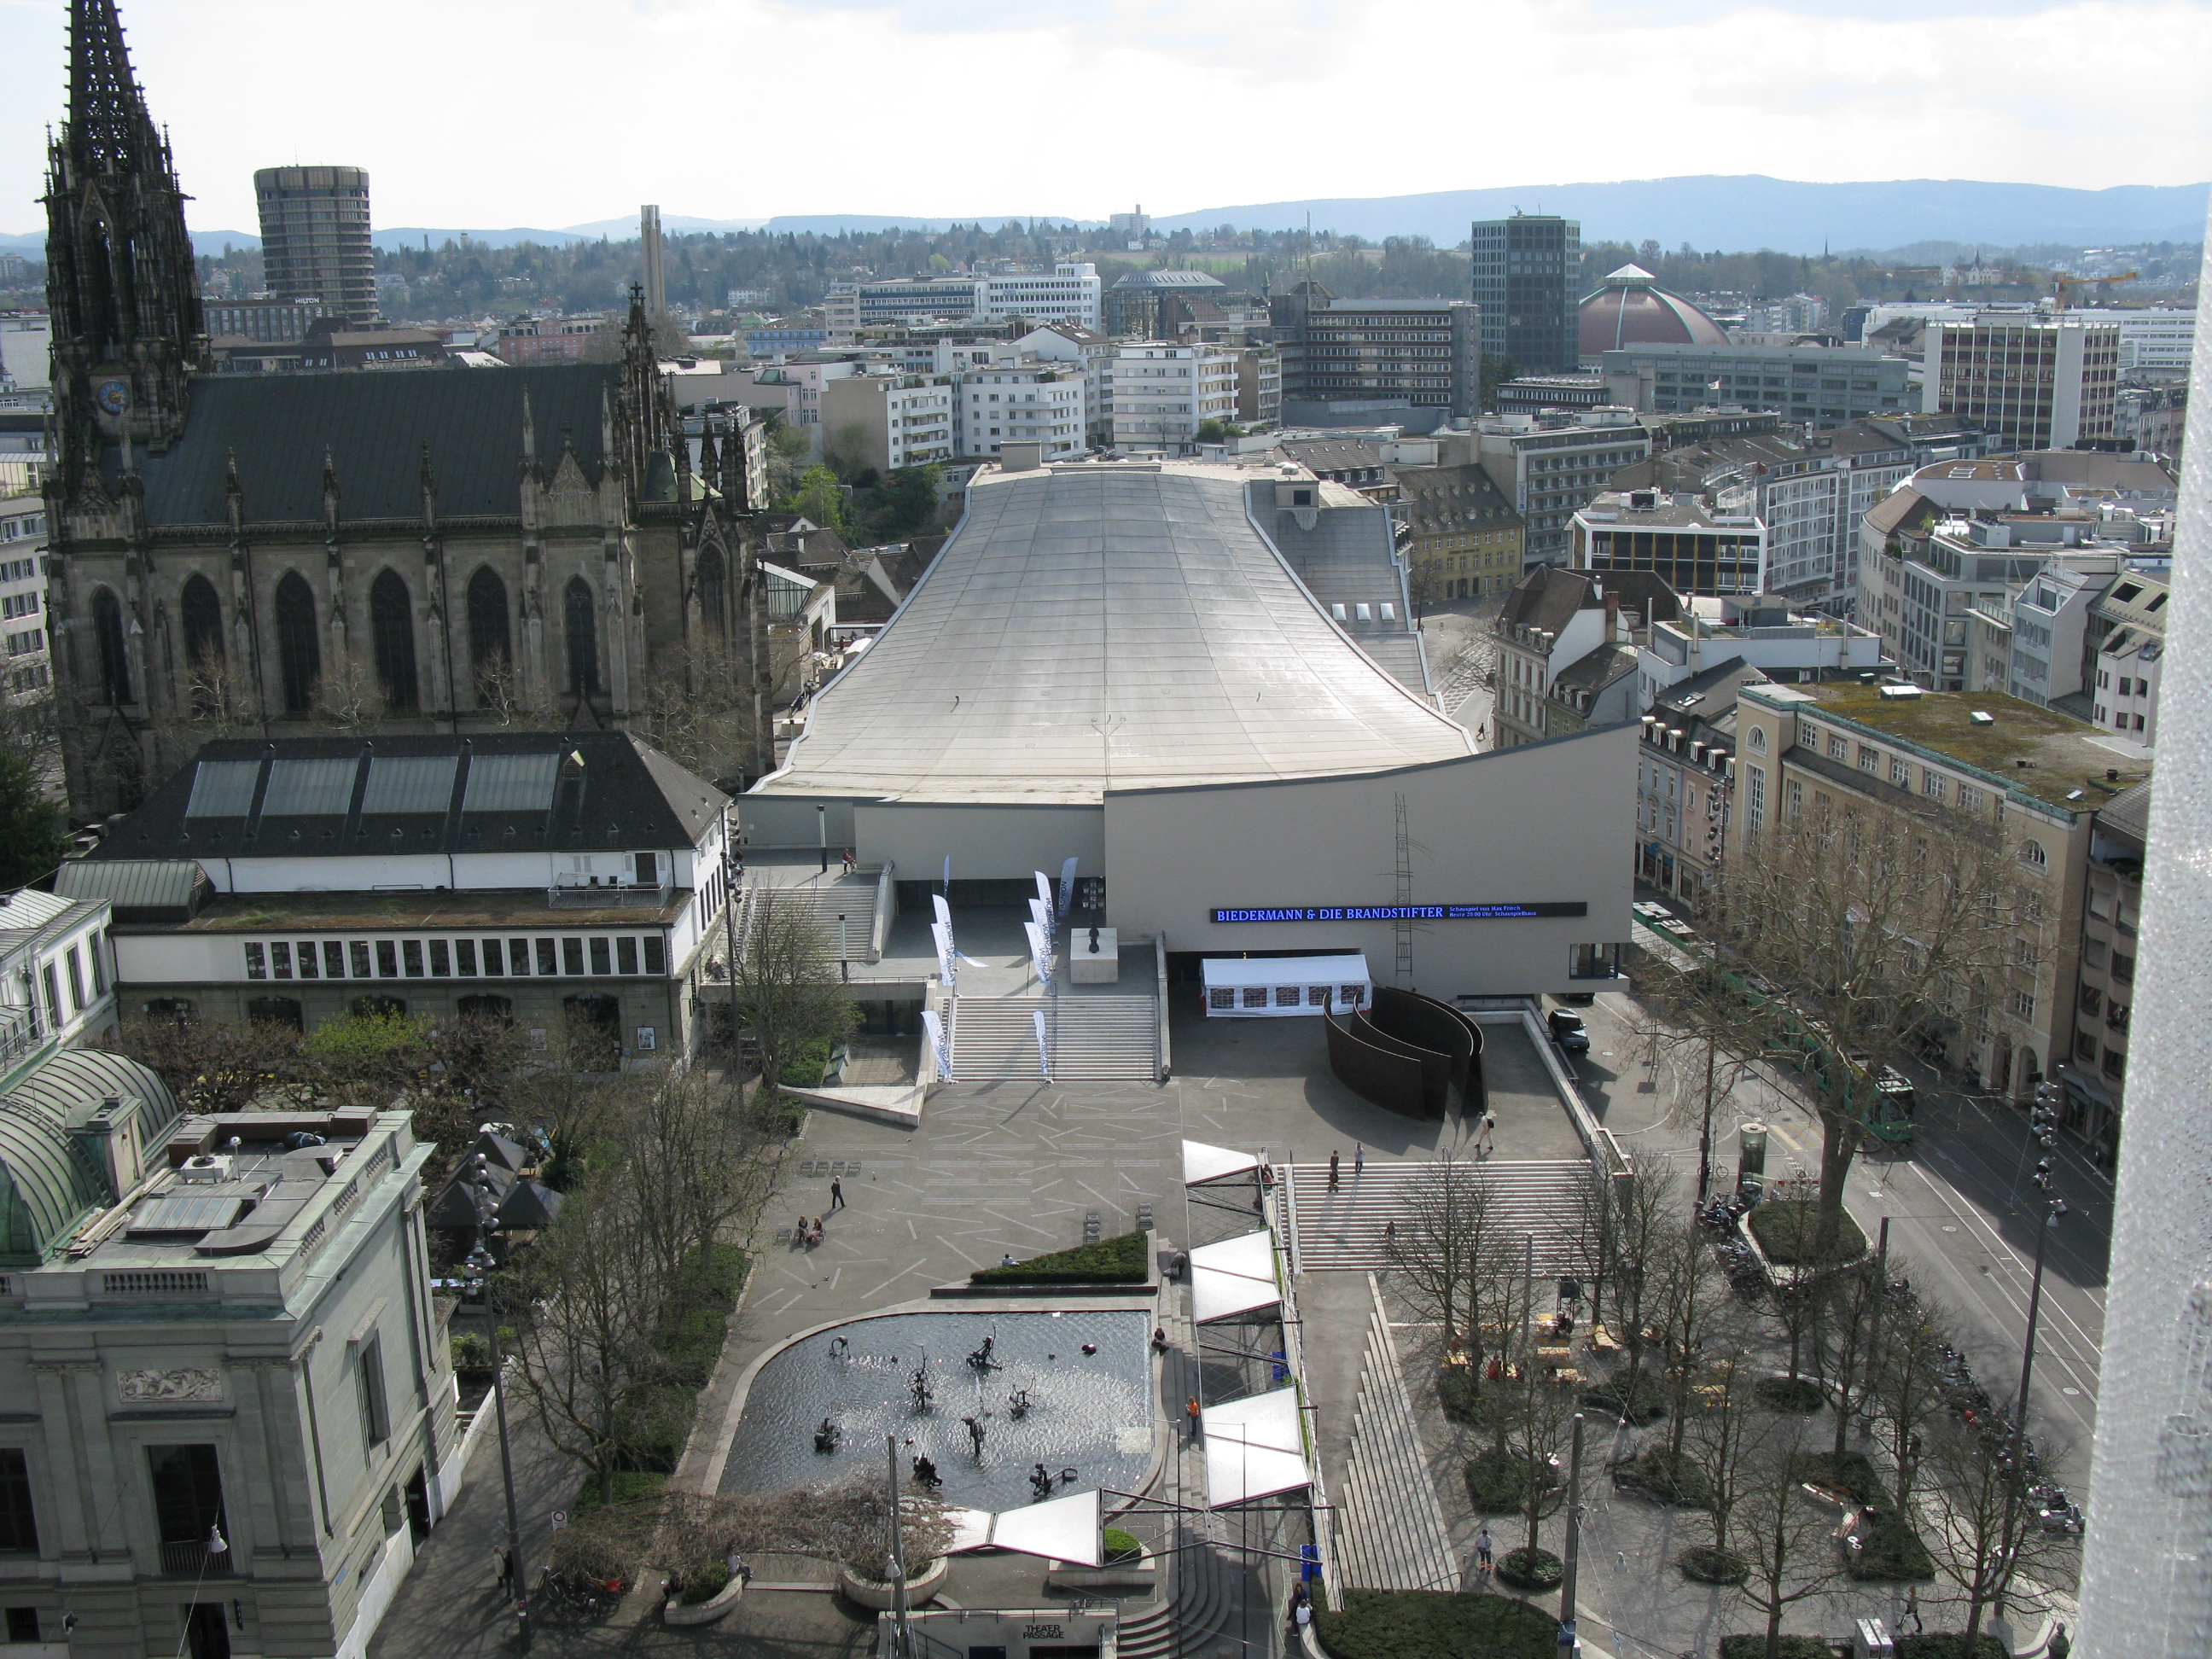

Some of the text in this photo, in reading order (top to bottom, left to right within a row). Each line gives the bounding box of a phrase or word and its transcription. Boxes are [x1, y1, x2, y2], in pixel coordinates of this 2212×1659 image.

[1216, 907, 1443, 921] BIEDERMANN & DIE BRANDSTIFTER
